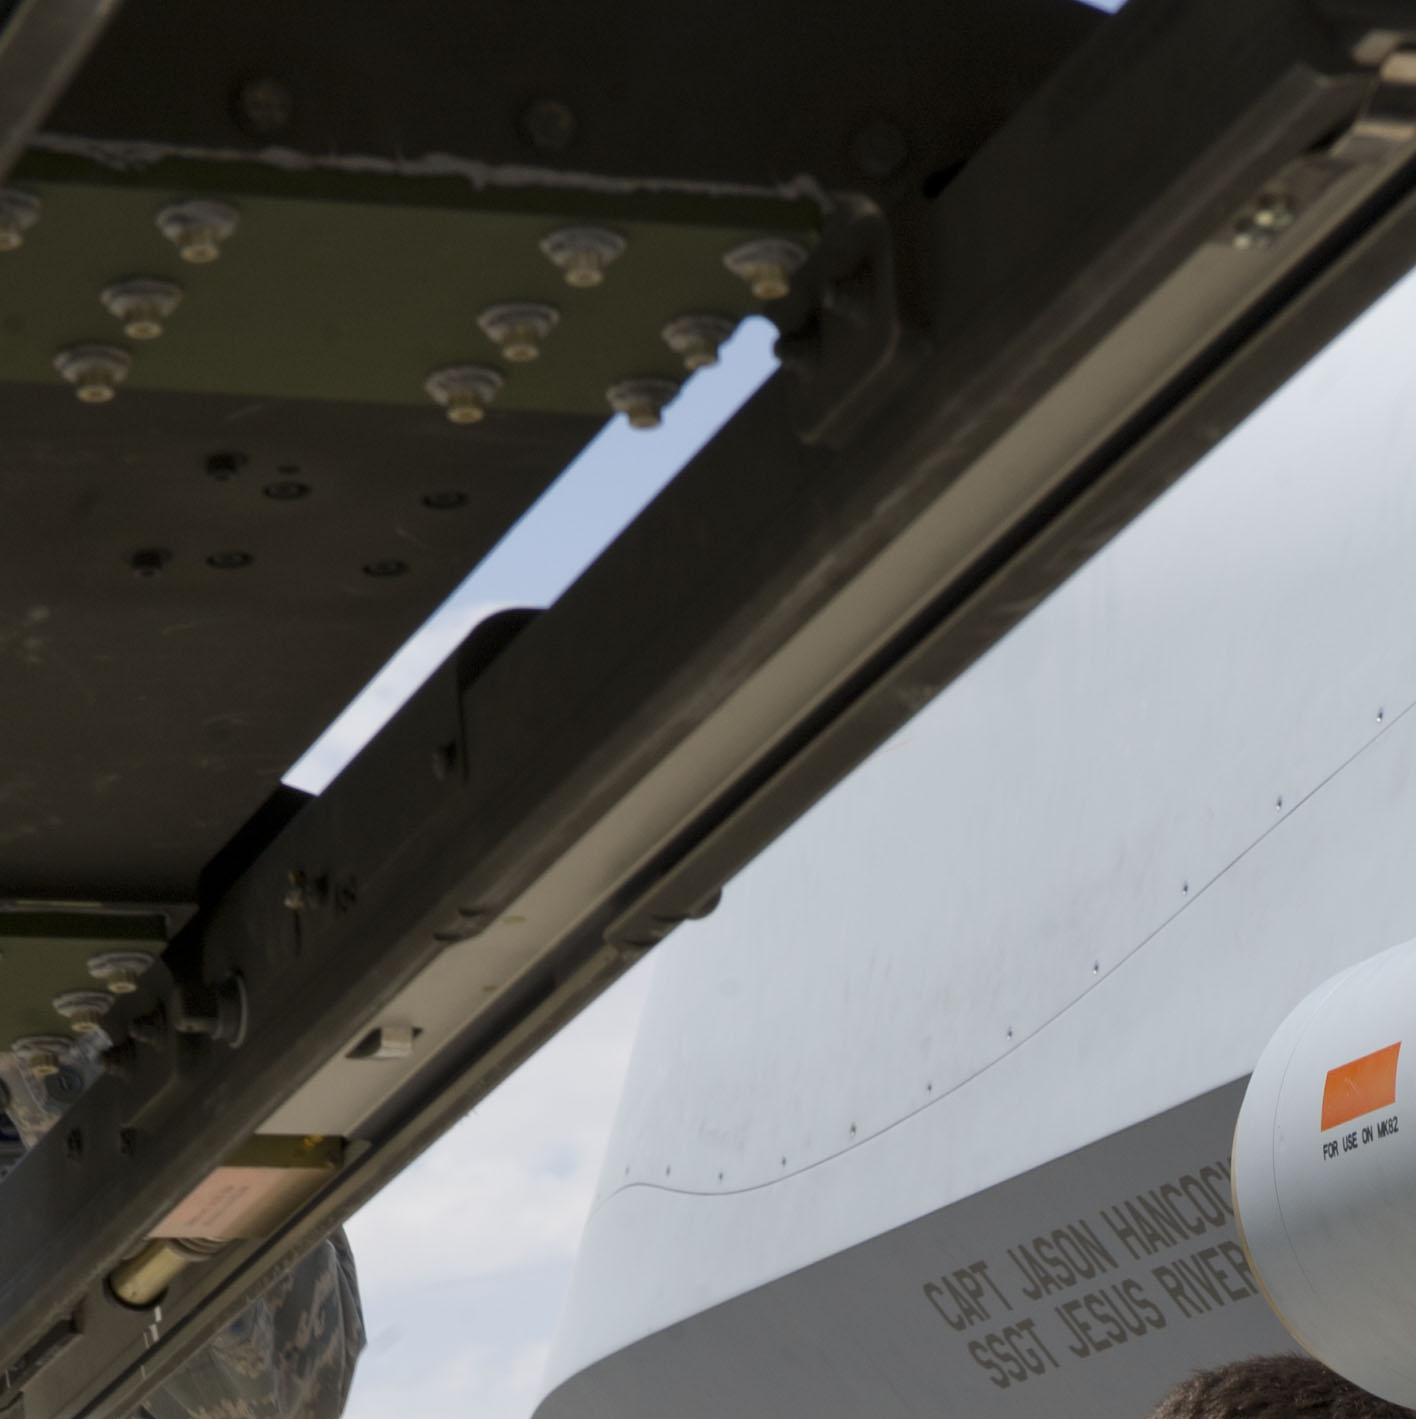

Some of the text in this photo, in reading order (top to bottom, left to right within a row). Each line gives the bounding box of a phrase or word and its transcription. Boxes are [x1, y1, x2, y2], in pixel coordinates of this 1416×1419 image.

[1323, 1115, 1399, 1160] FOR USE ON MK82
[923, 1156, 1237, 1331] CAPT JASON HANCOC
[968, 1317, 1060, 1389] SSGT
[1054, 1278, 1167, 1359] JESUS
